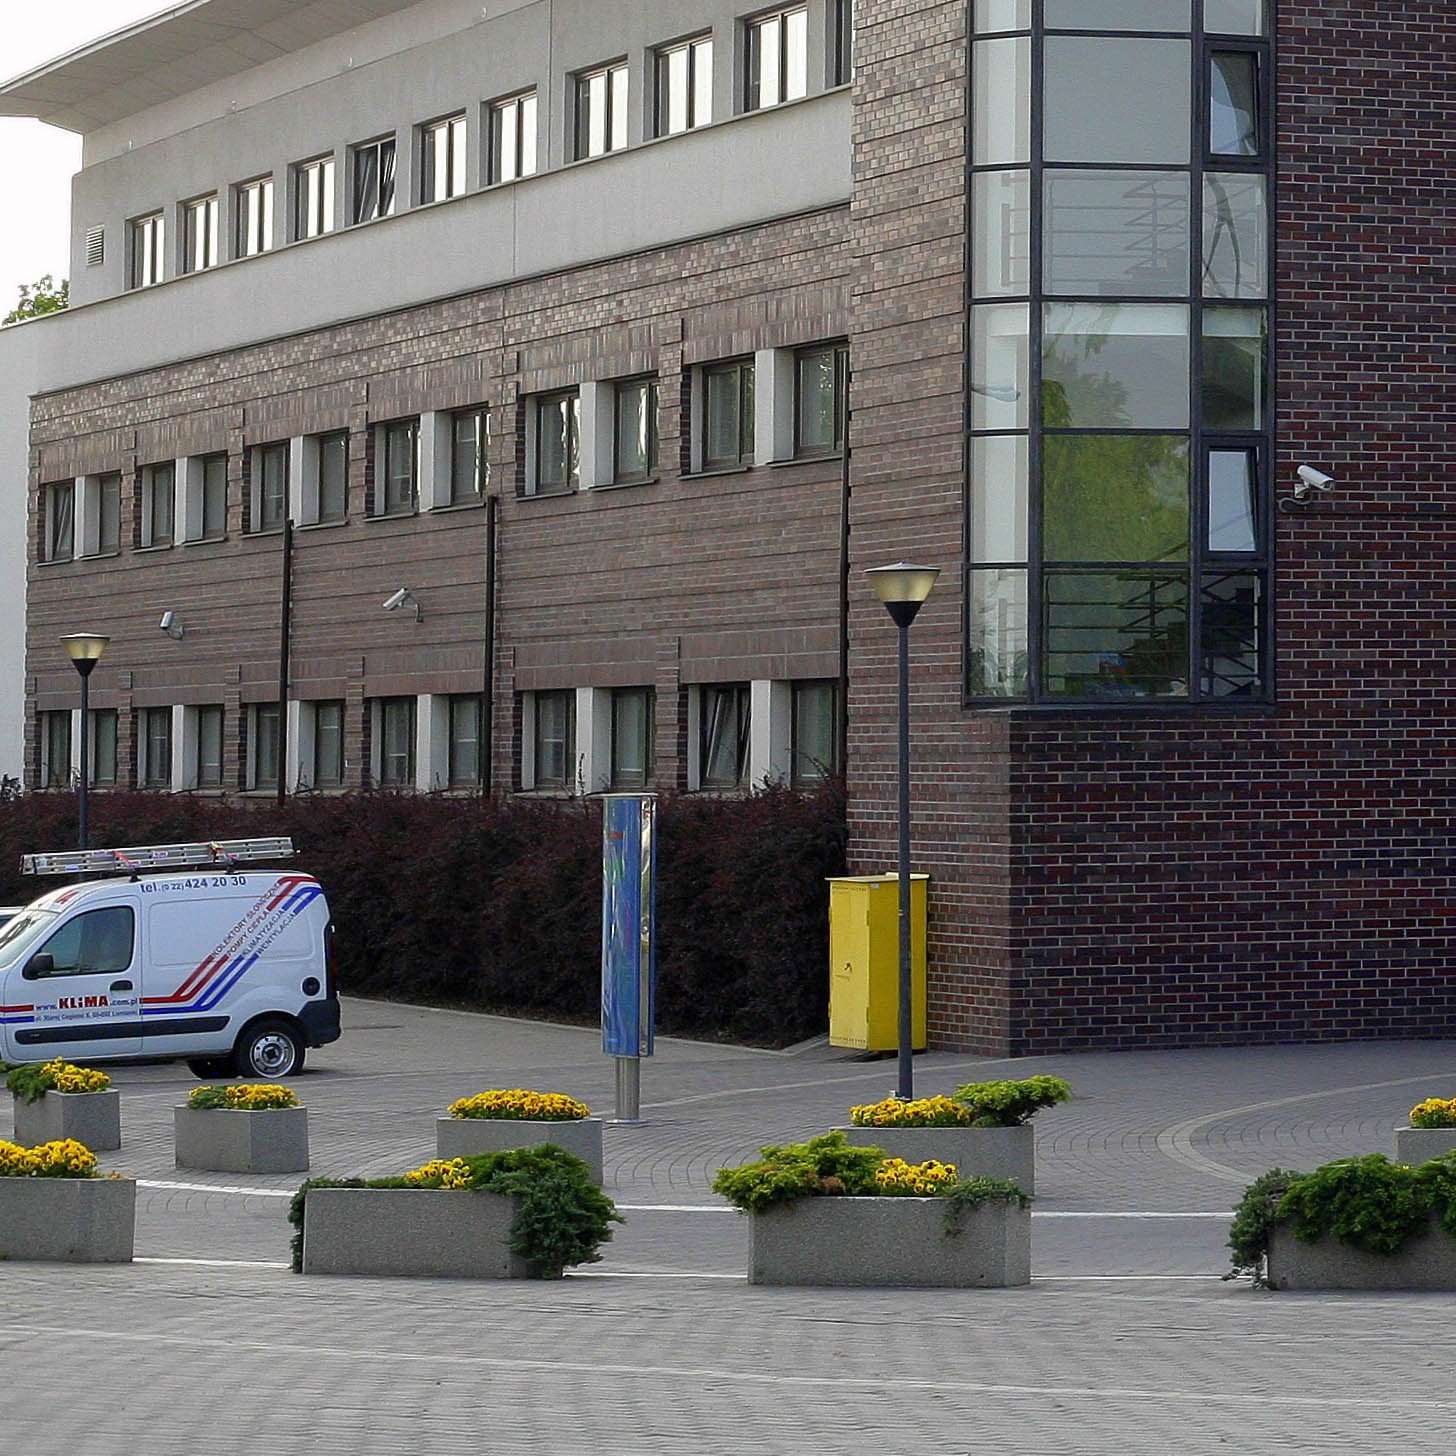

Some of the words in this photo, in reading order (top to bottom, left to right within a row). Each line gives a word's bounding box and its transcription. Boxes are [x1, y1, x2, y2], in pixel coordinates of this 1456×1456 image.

[140, 882, 160, 893] tel.
[212, 877, 227, 887] 20
[231, 876, 247, 886] 30
